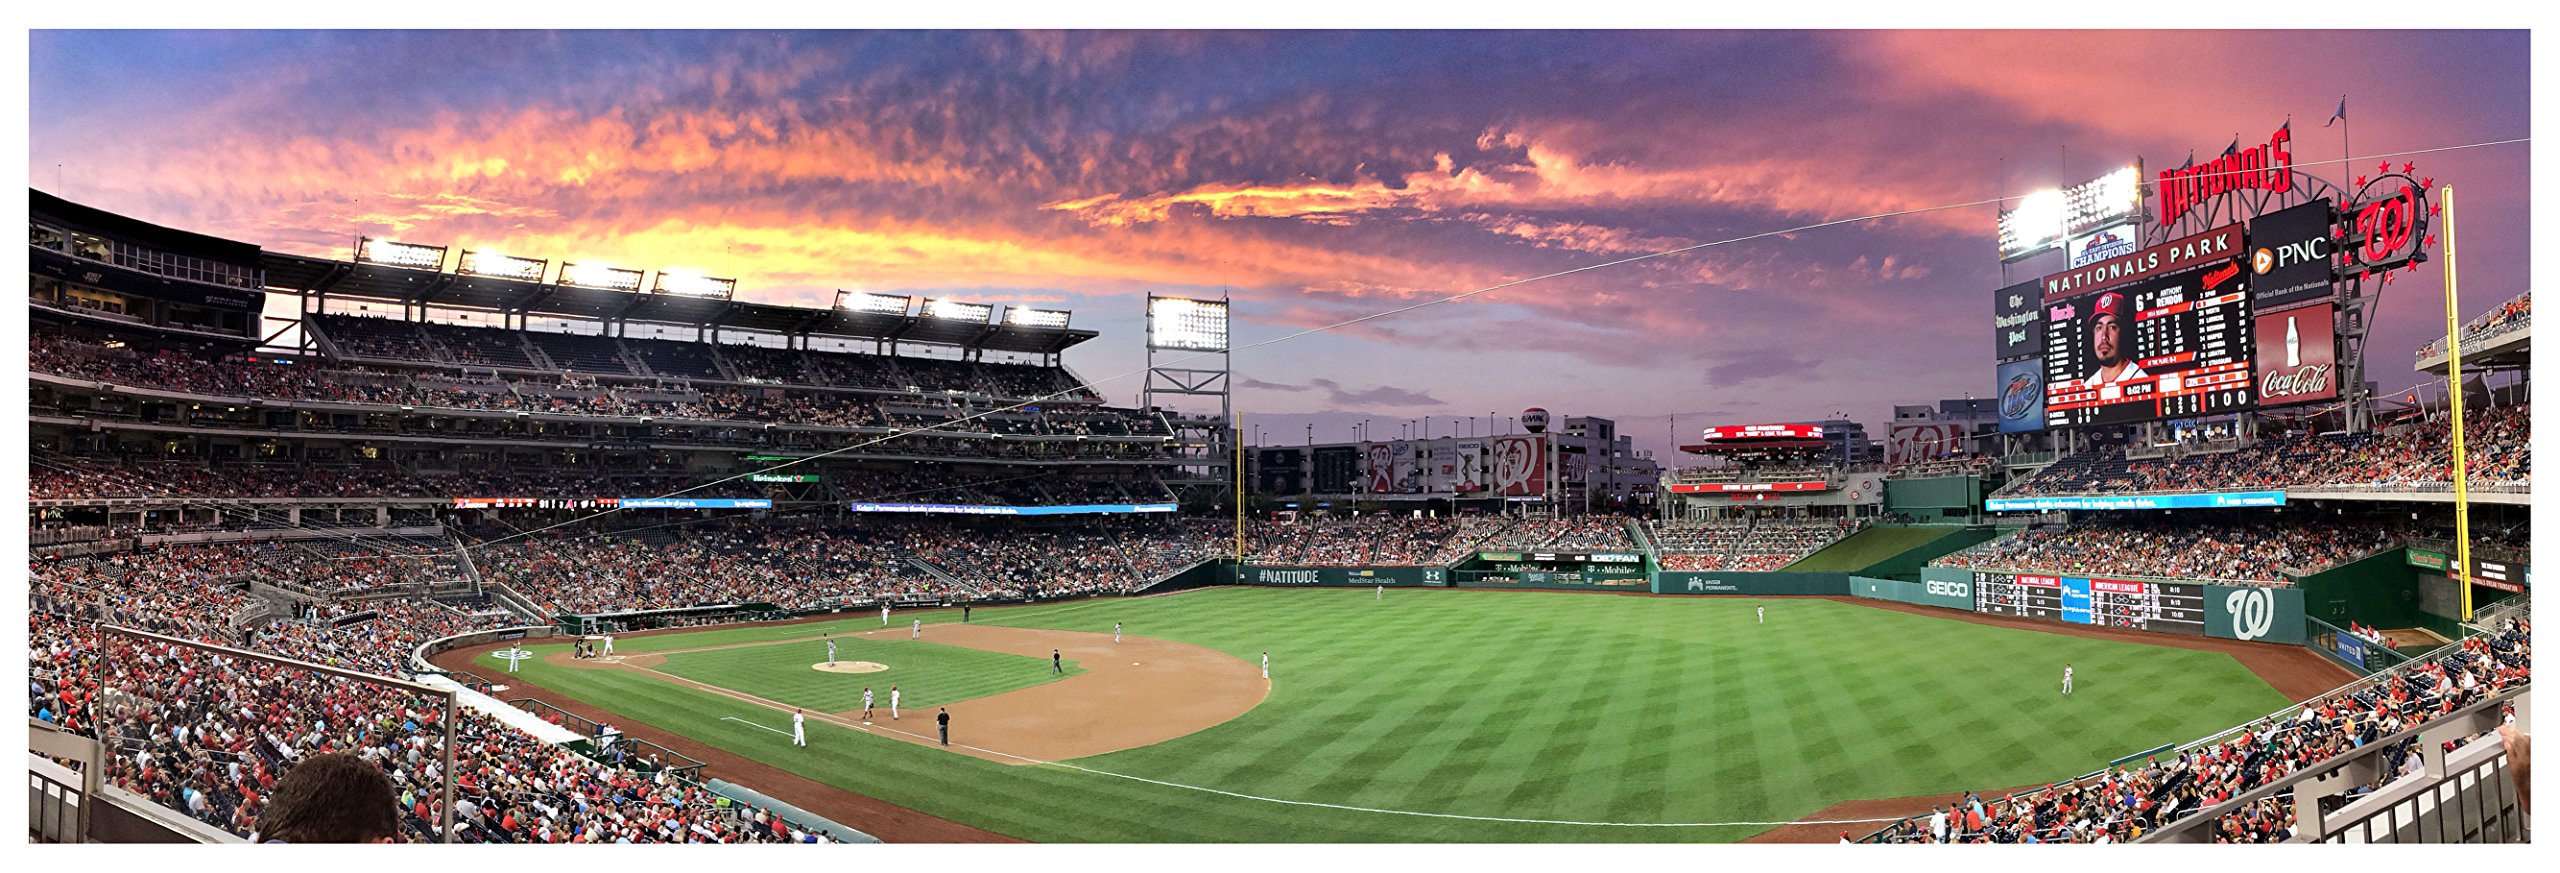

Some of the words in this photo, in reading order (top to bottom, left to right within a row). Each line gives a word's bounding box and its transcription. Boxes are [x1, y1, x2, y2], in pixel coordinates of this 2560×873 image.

[2160, 129, 2292, 227] NATIONALS
[2074, 242, 2133, 269] CHAMPIONS
[2277, 237, 2326, 267] PNC
[2049, 252, 2158, 294] NATIONALS
[2170, 233, 2229, 263] PARK
[2160, 285, 2183, 297] ANTHONY
[2256, 290, 2274, 300] Official
[2275, 287, 2288, 296] Bank
[2289, 285, 2294, 293] of
[2303, 279, 2329, 290] Nationals
[2009, 294, 2023, 308] The
[2135, 294, 2144, 311] 6
[2156, 293, 2183, 308] RENDON
[1996, 310, 2039, 328] Washington
[2009, 329, 2026, 347] Post
[2126, 385, 2140, 395] 8:02
[2141, 384, 2151, 393] PM
[2262, 364, 2330, 398] Coca-Cola
[2178, 396, 2183, 405] 2
[2191, 394, 2196, 403] 0
[2209, 394, 2215, 407] 1
[2223, 392, 2231, 406] 0
[2238, 390, 2246, 404] 0
[2165, 406, 2170, 415] 0
[2178, 405, 2183, 414] 2
[2191, 403, 2197, 412] 0
[539, 499, 549, 509] 91
[48, 509, 64, 519] PNC
[1259, 569, 1319, 583] #NATITUDE
[1926, 580, 1968, 597] GEICO
[2095, 581, 2118, 590] AMERICAN
[2119, 583, 2139, 591] LEAGUE
[2226, 588, 2274, 640] W
[2338, 641, 2356, 655] UNITED
